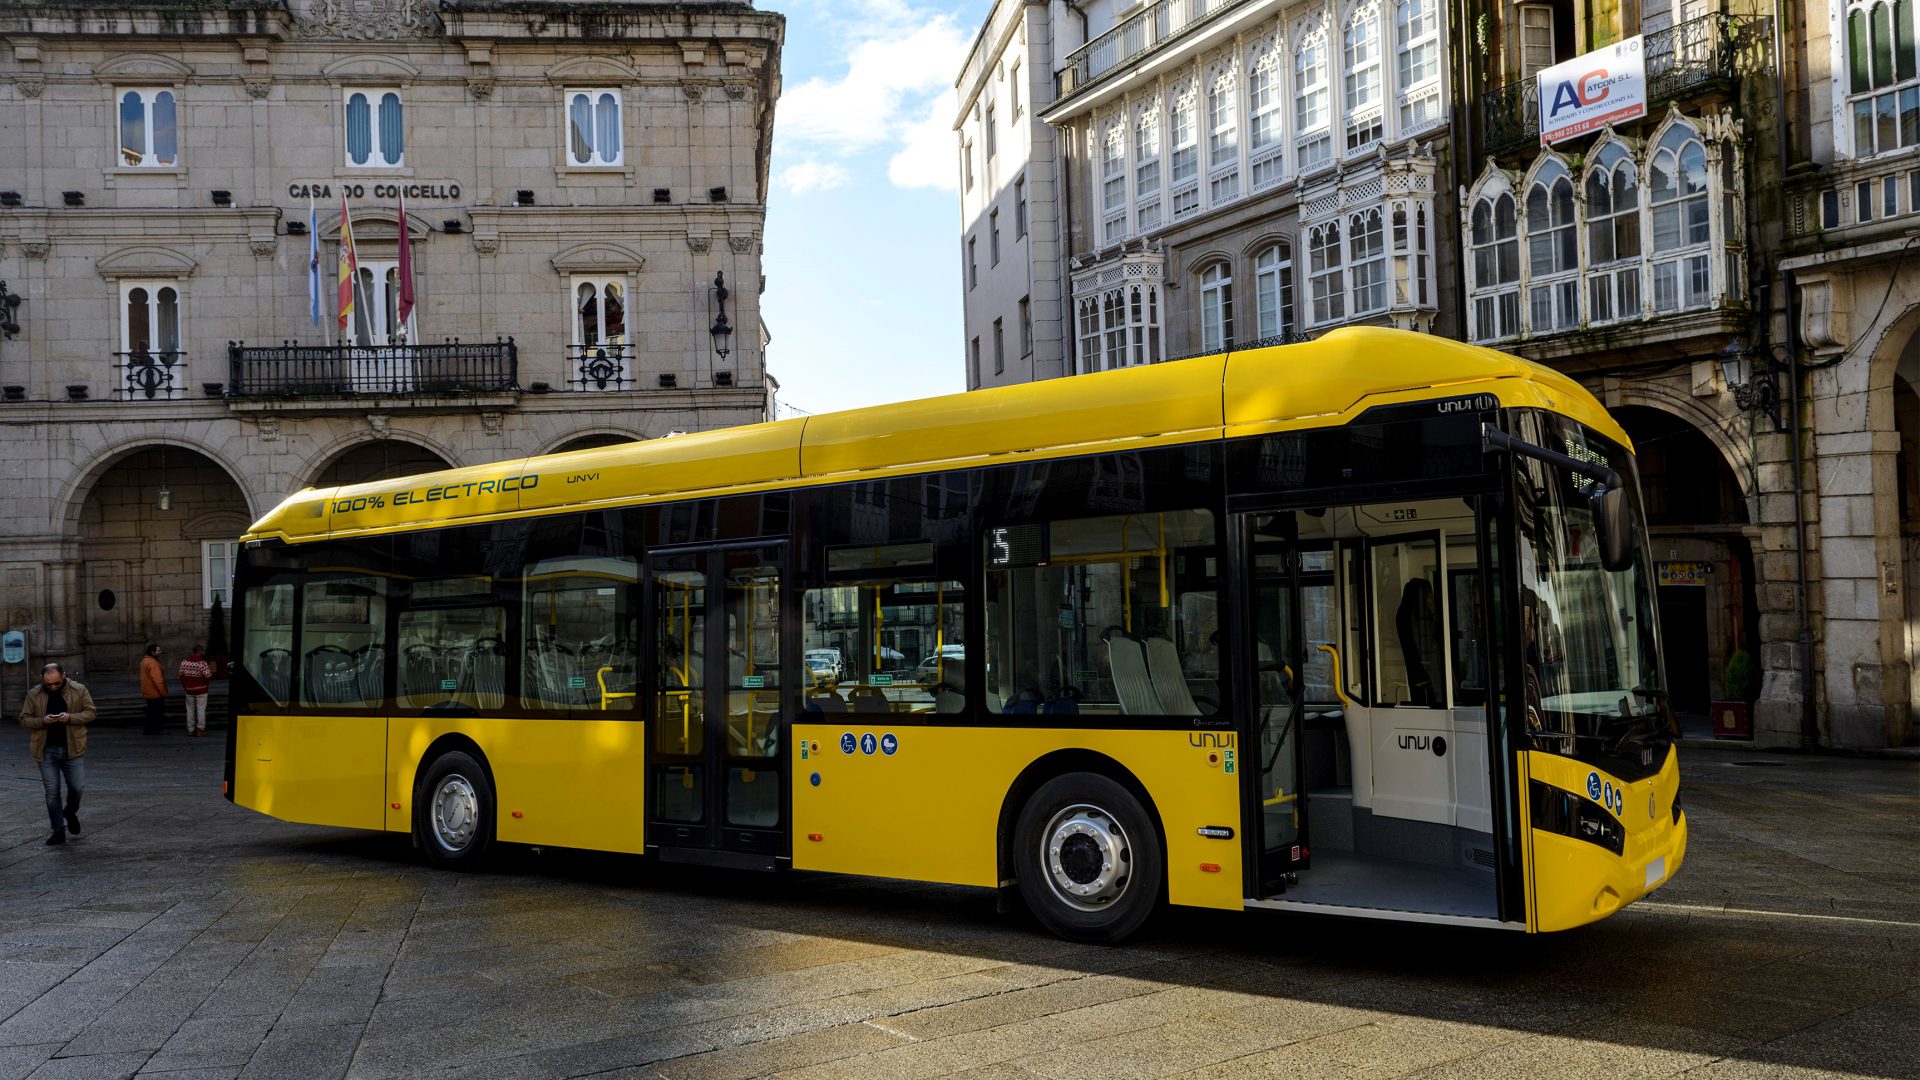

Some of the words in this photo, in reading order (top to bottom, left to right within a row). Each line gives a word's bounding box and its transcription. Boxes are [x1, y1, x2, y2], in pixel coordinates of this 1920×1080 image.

[1587, 76, 1616, 93] ATCON
[1618, 73, 1633, 82] S.L.
[1582, 96, 1626, 114] CONSTRUCCIONES
[289, 184, 332, 199] CASA
[342, 184, 365, 198] DO
[374, 184, 461, 200] CONCELLO
[567, 472, 600, 484] UNVI
[331, 495, 385, 515] 100%
[393, 474, 539, 506] ELÉCTRICO
